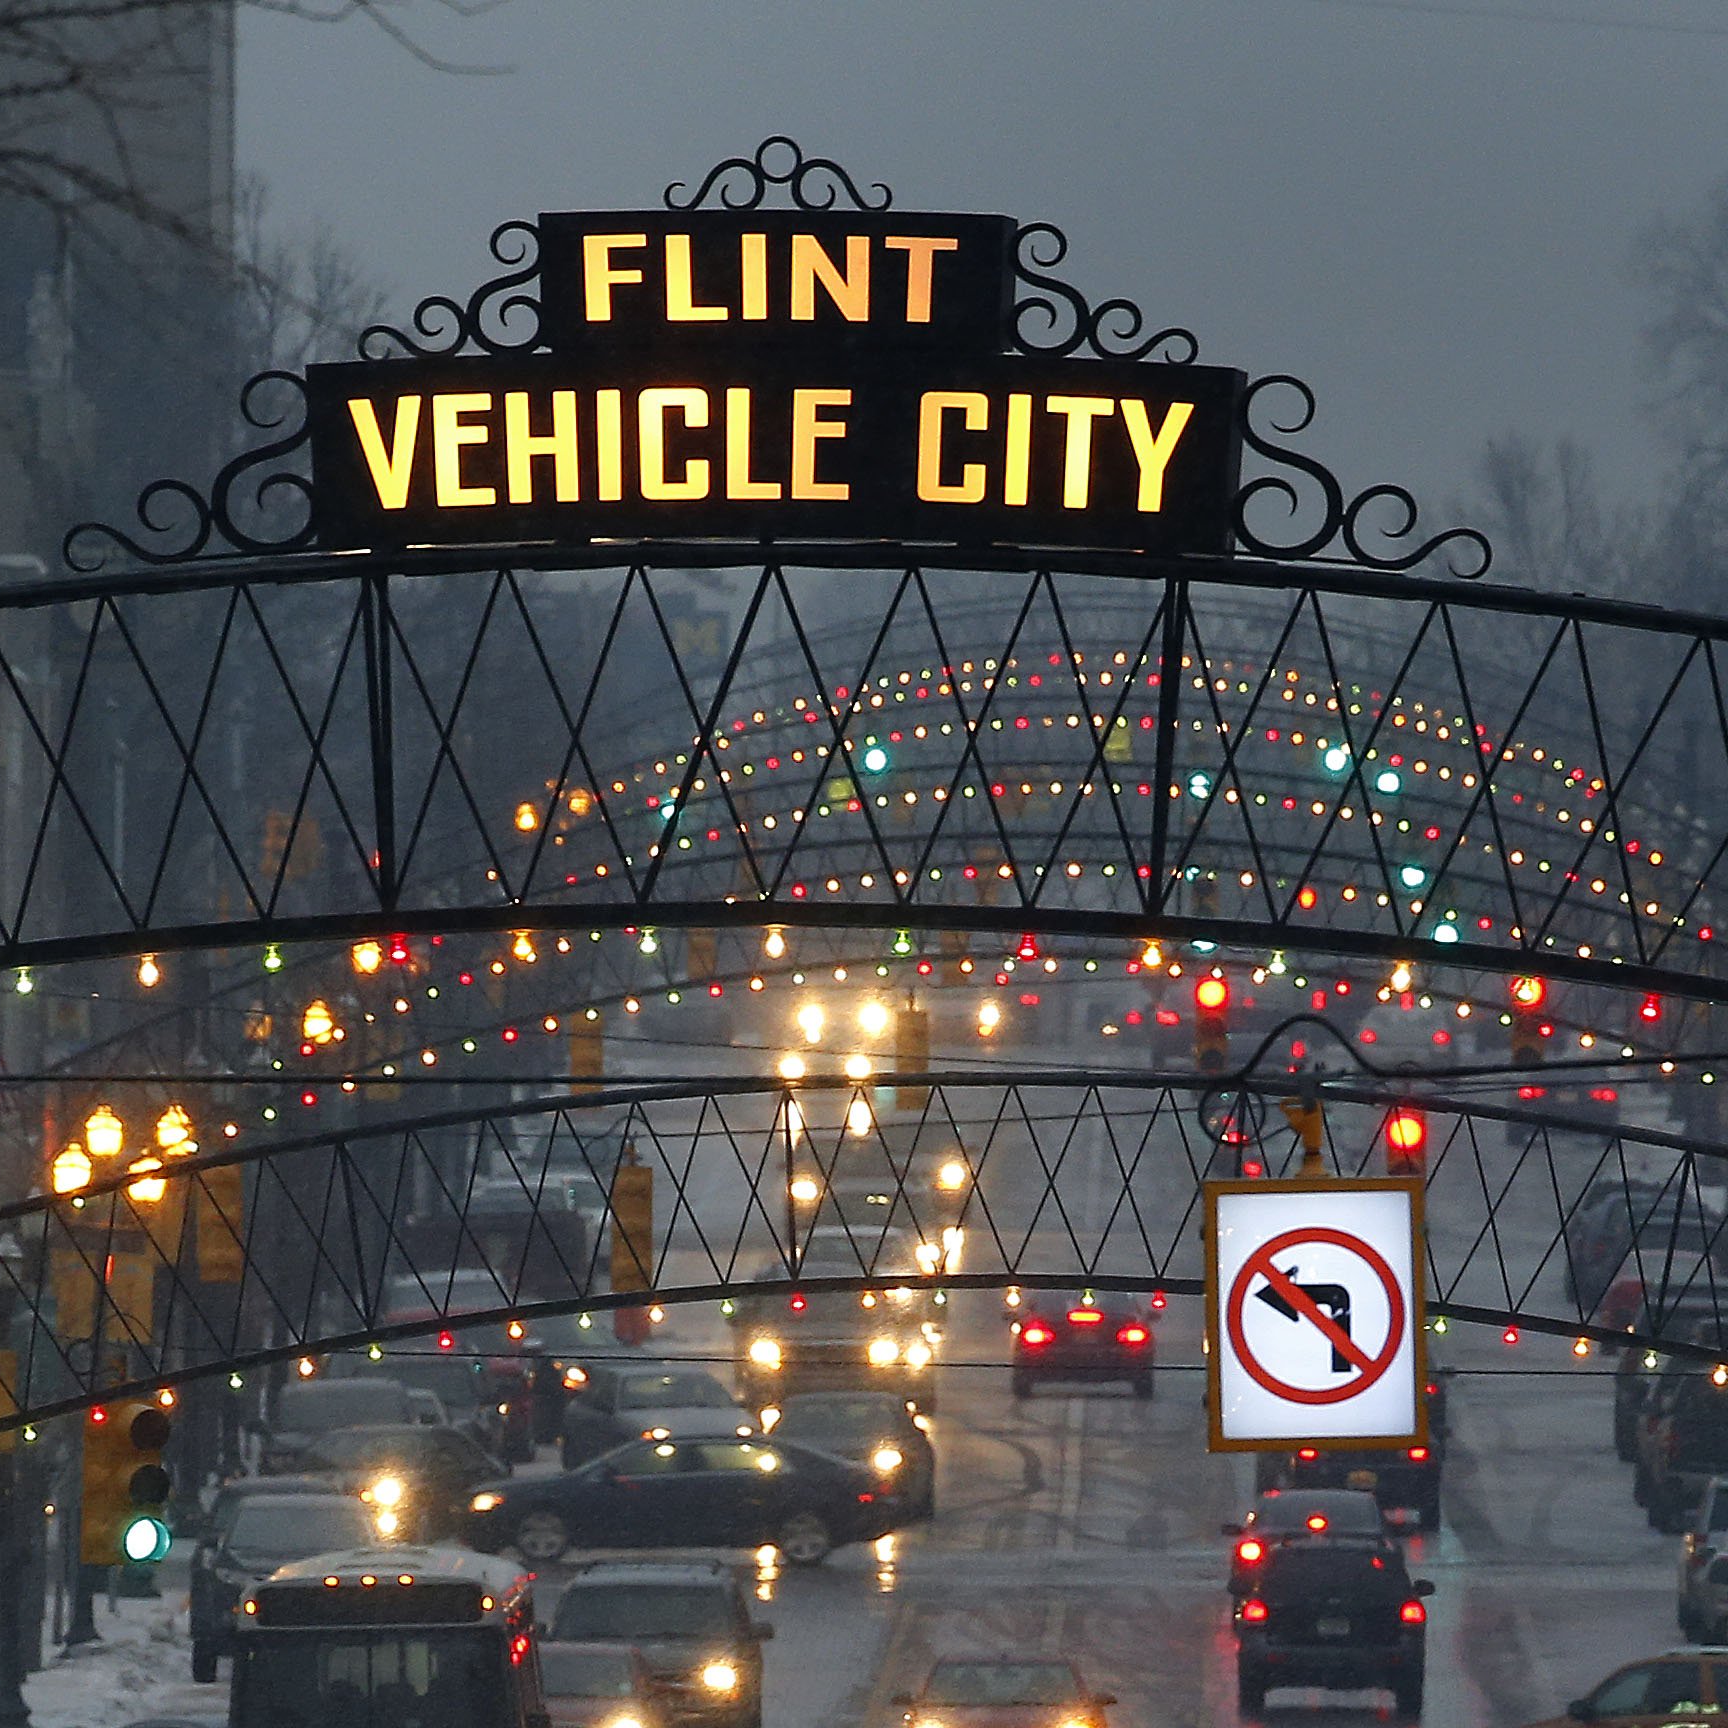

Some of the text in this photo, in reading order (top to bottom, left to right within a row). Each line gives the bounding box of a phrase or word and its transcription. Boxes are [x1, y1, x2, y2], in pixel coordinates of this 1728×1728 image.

[580, 232, 960, 324] FLINT
[348, 387, 1196, 514] VEHICLE CITY
